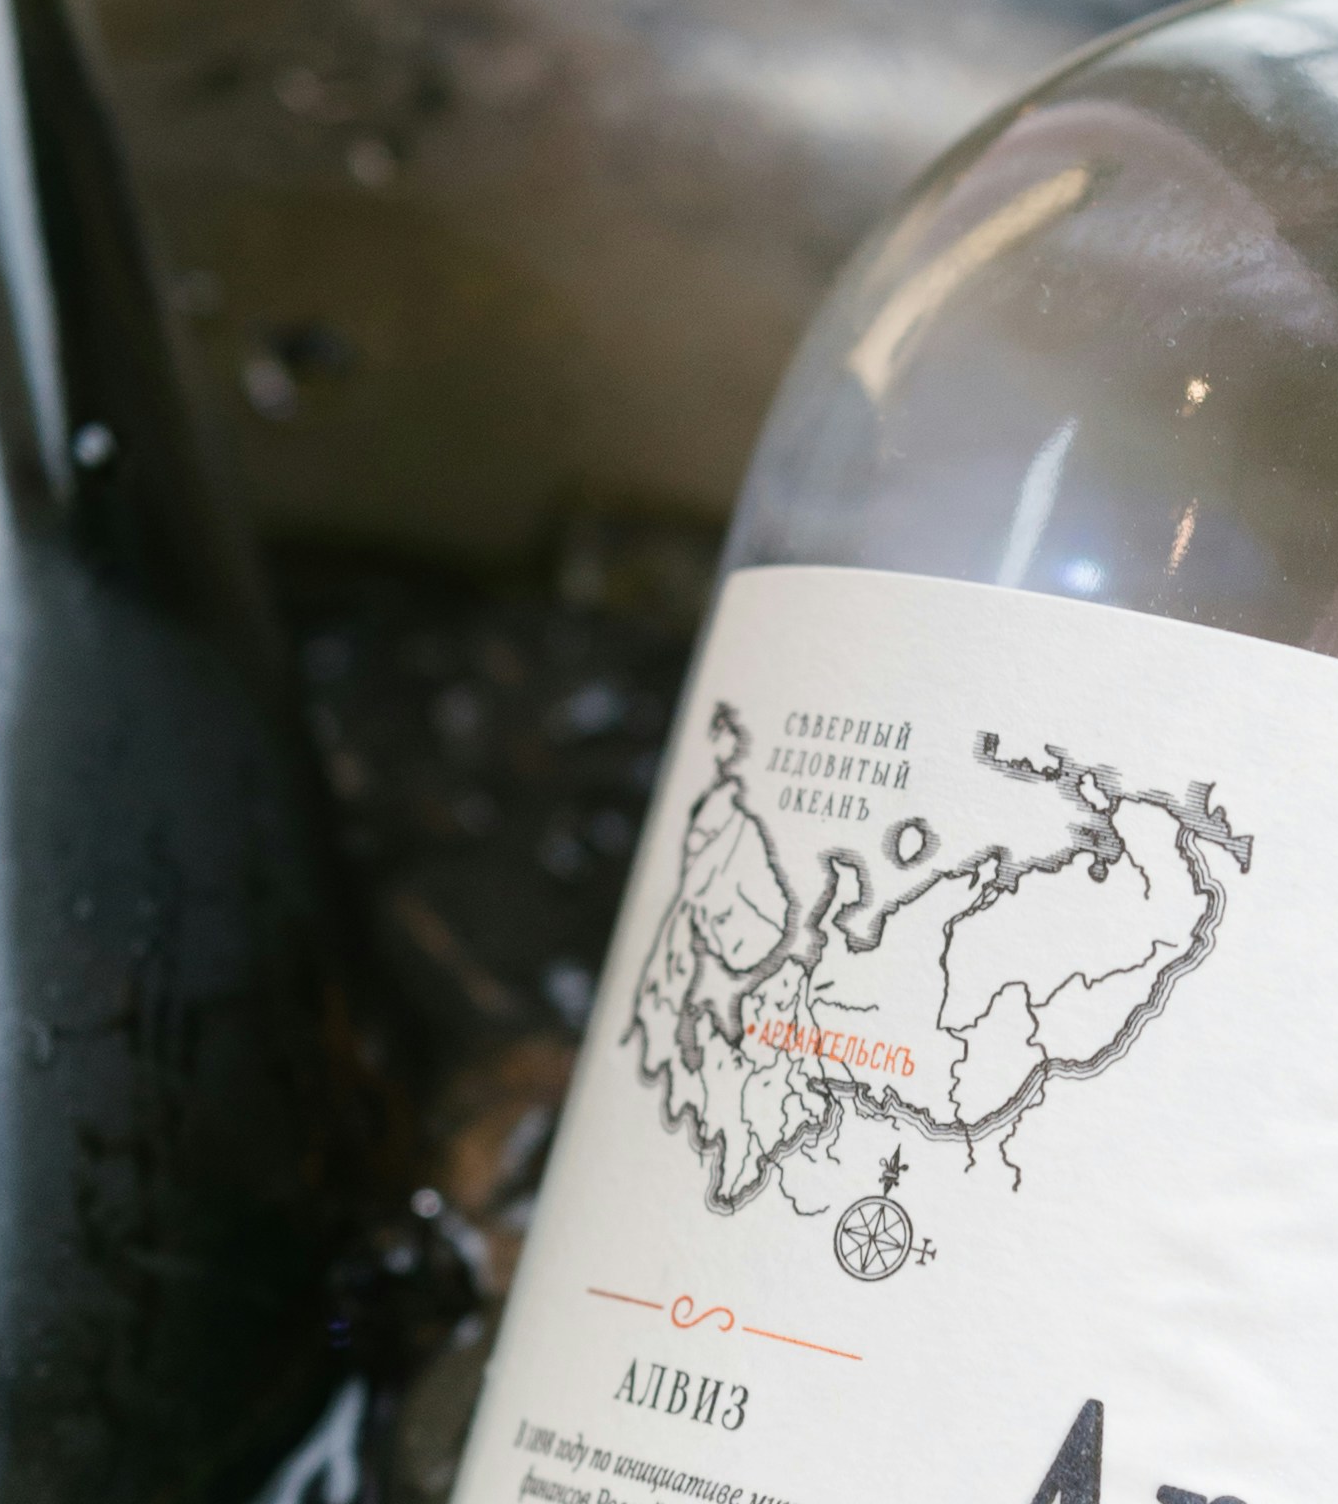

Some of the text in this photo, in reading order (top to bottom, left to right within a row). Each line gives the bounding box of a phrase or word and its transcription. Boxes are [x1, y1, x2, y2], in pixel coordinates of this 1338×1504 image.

[765, 746, 911, 791] ЛЕДОВИТЫЙ
[778, 785, 870, 822] ОКЕАНЪ
[757, 1018, 916, 1078] АРХАНГЕЛЬСКЪ
[613, 1357, 751, 1432] АЛВИЗ
[555, 1432, 590, 1473] году
[589, 1447, 611, 1471] по
